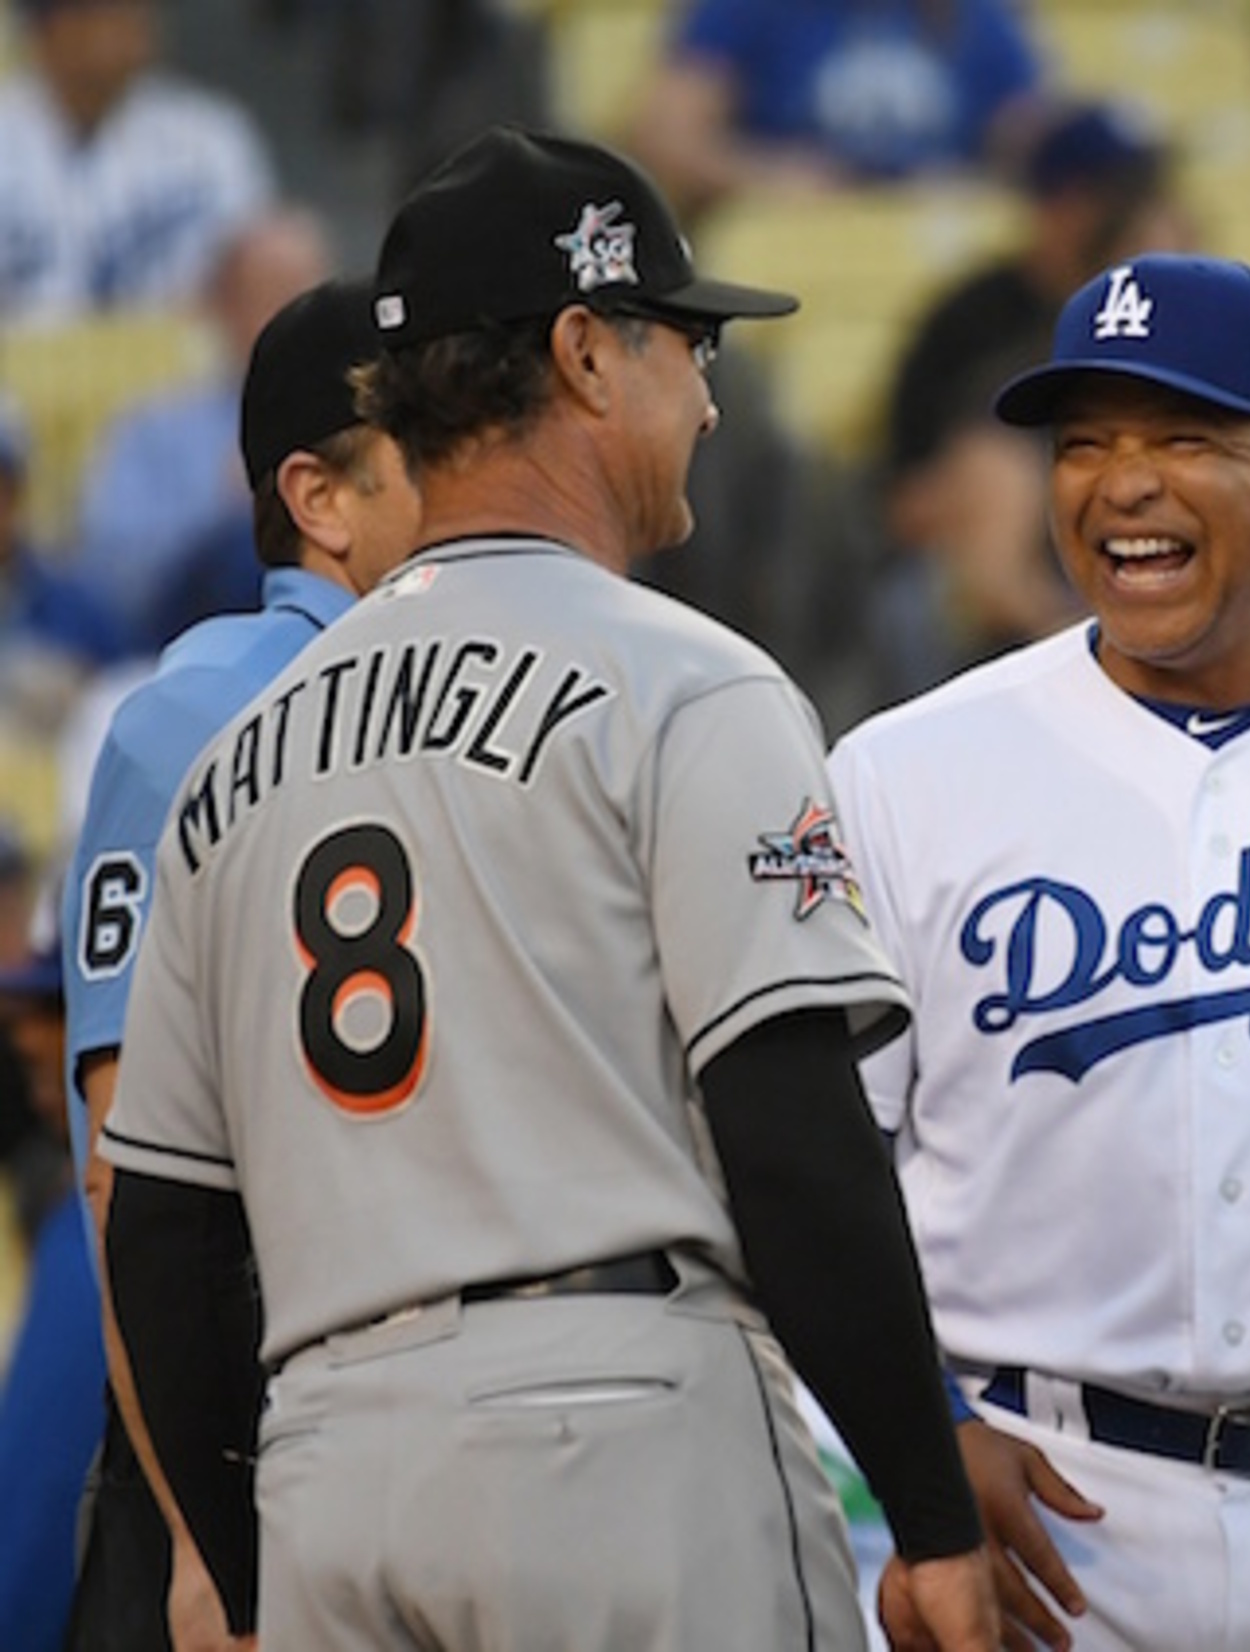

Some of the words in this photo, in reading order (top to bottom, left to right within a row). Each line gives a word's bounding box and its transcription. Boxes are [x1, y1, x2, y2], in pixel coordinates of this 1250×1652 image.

[1096, 266, 1152, 338] LA
[177, 641, 608, 875] MATTINGLY
[78, 853, 148, 981] 6
[293, 817, 430, 1118] 8
